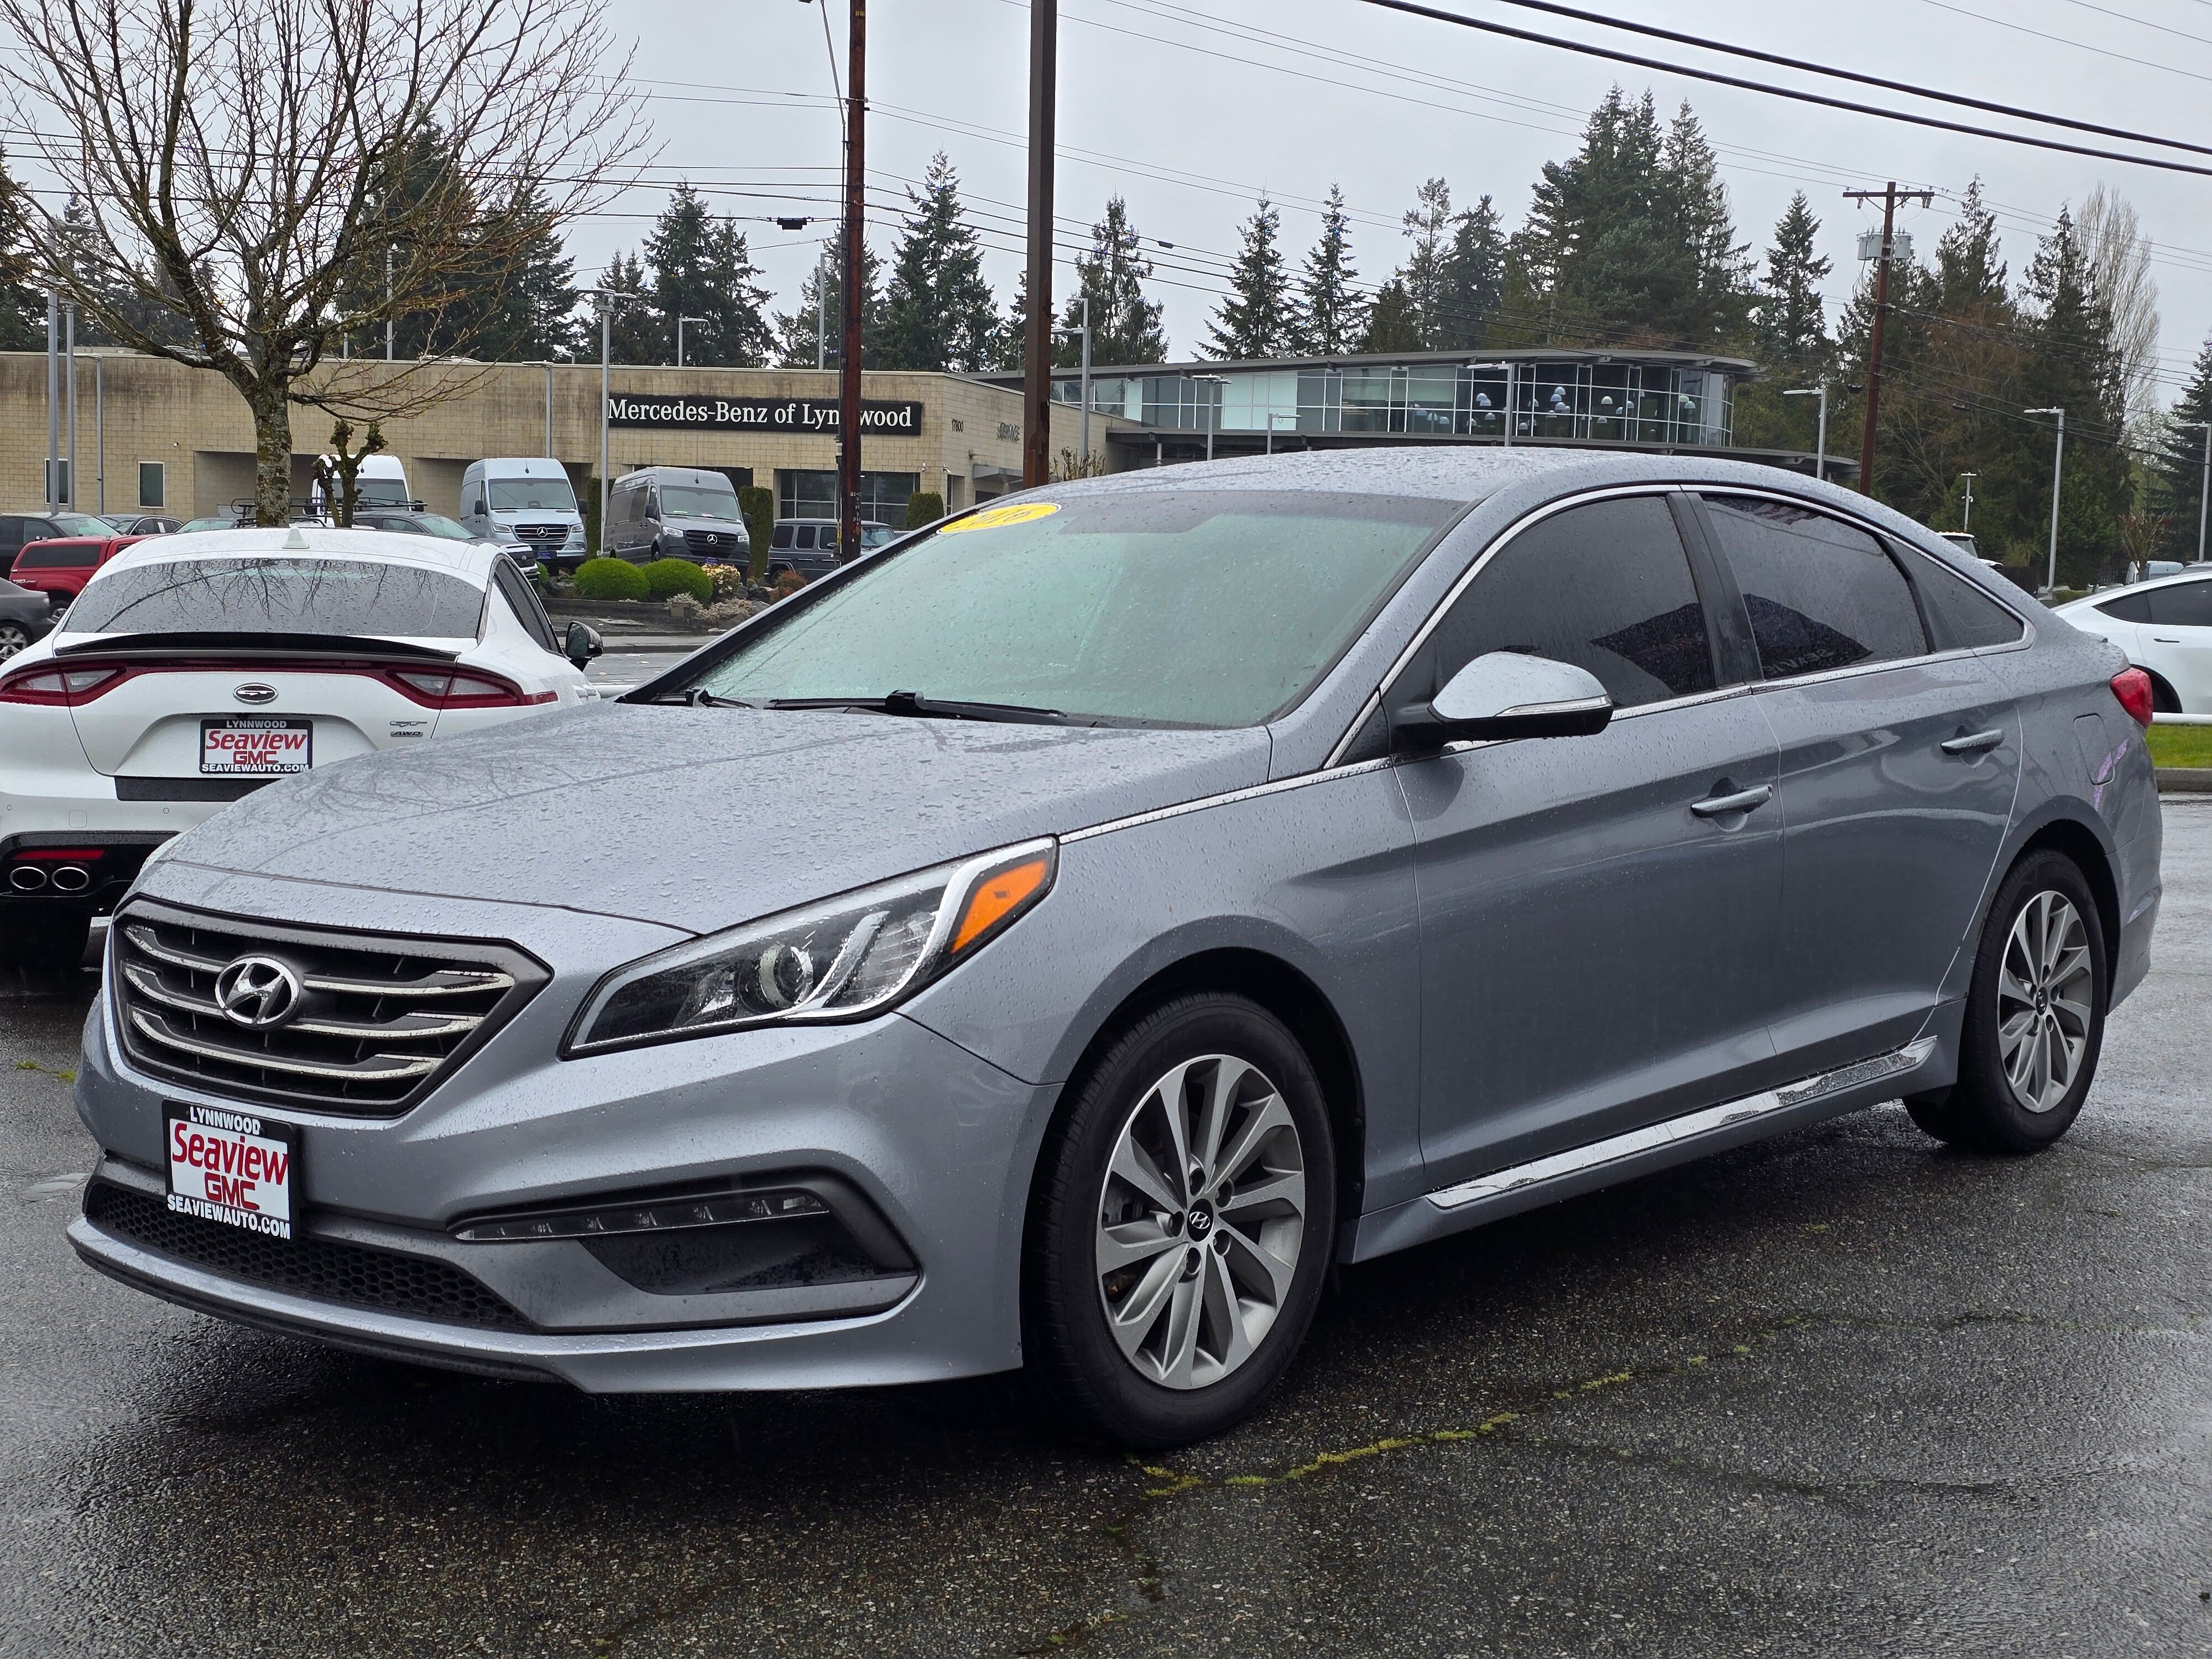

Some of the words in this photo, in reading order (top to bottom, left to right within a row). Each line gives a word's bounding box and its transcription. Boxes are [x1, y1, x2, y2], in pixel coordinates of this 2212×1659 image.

[608, 399, 768, 423] Mercedes-Benz
[774, 403, 796, 424] of
[802, 404, 912, 430] Lynwood
[951, 419, 964, 433] 17800
[226, 720, 287, 728] LYNNWOOD
[206, 730, 307, 750] Seaview
[202, 764, 310, 772] SEAVIEWAUTO.COM
[233, 750, 279, 764] GMC
[190, 1106, 261, 1135] LYNNWOOD
[172, 1123, 288, 1186] Seaview
[204, 1171, 260, 1211] GMC
[167, 1194, 290, 1240] SEAVIEWAUTO.COM
